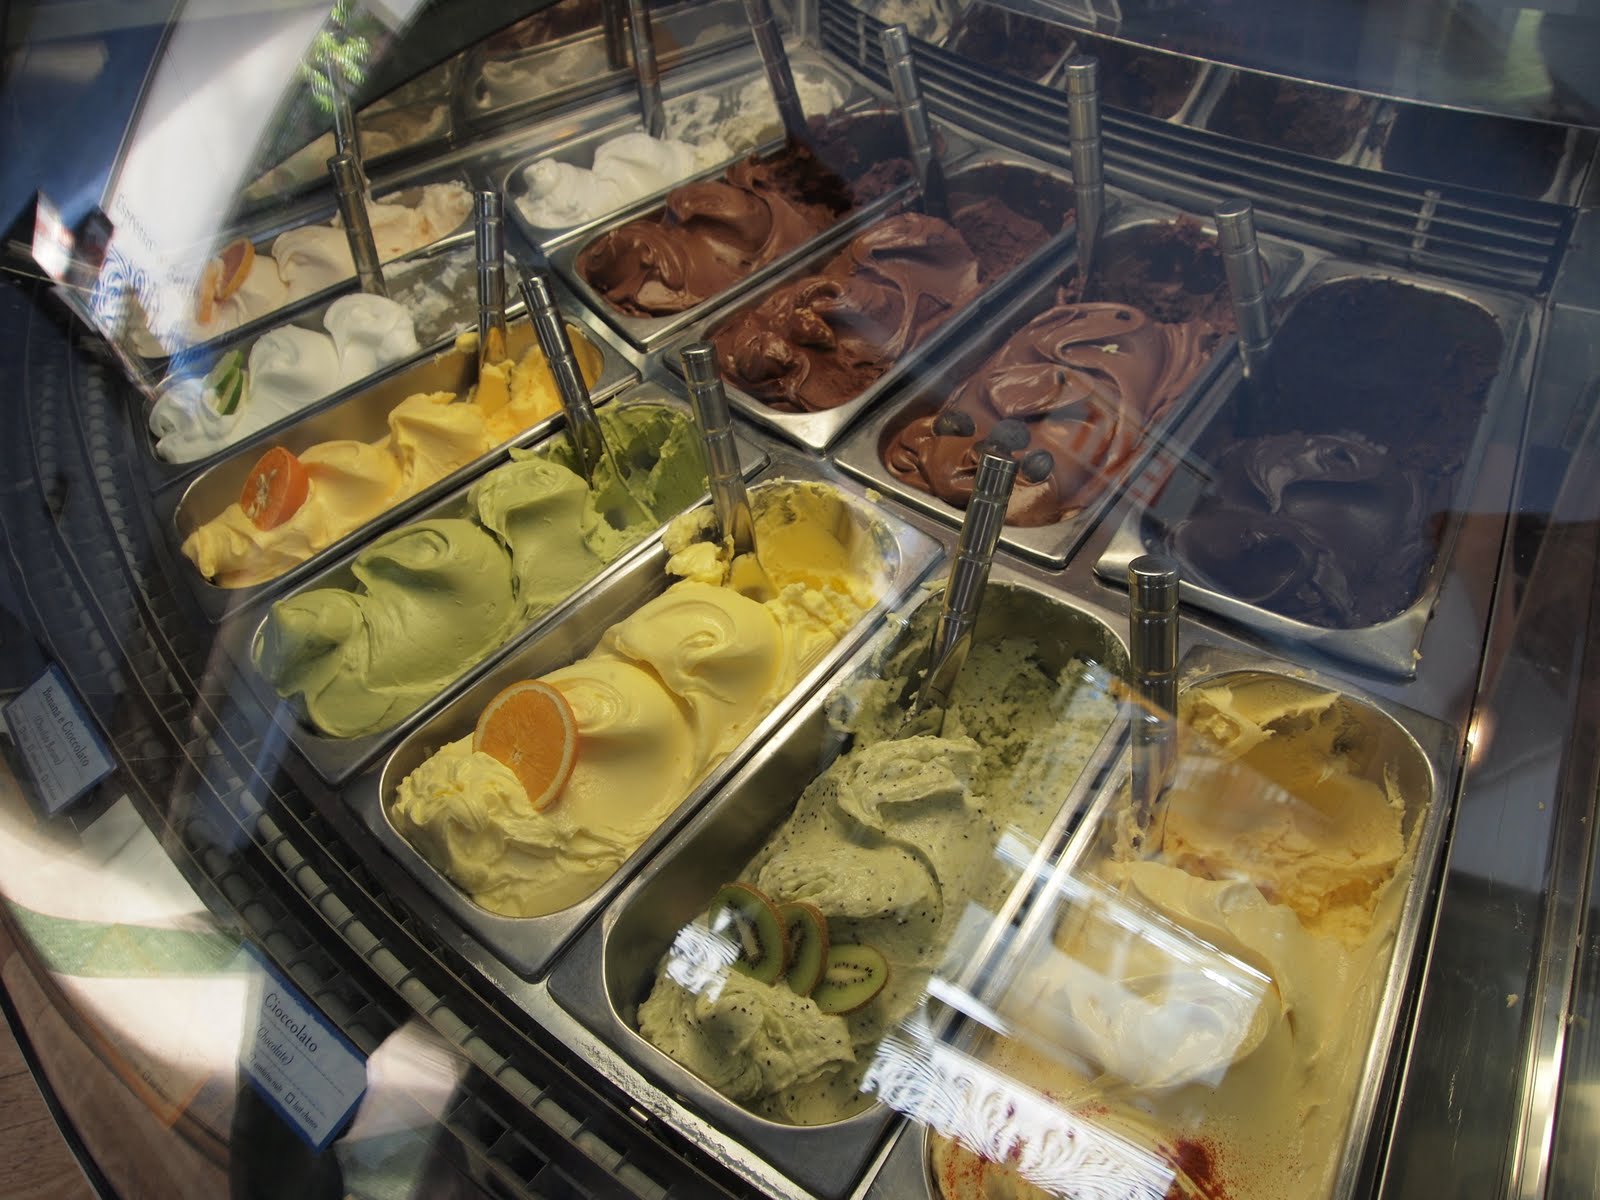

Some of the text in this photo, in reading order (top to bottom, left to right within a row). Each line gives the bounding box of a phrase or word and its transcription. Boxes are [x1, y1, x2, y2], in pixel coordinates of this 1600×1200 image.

[42, 686, 61, 719] Banana
[62, 721, 89, 768] Cioccolato
[264, 992, 318, 1053] Cioccolato
